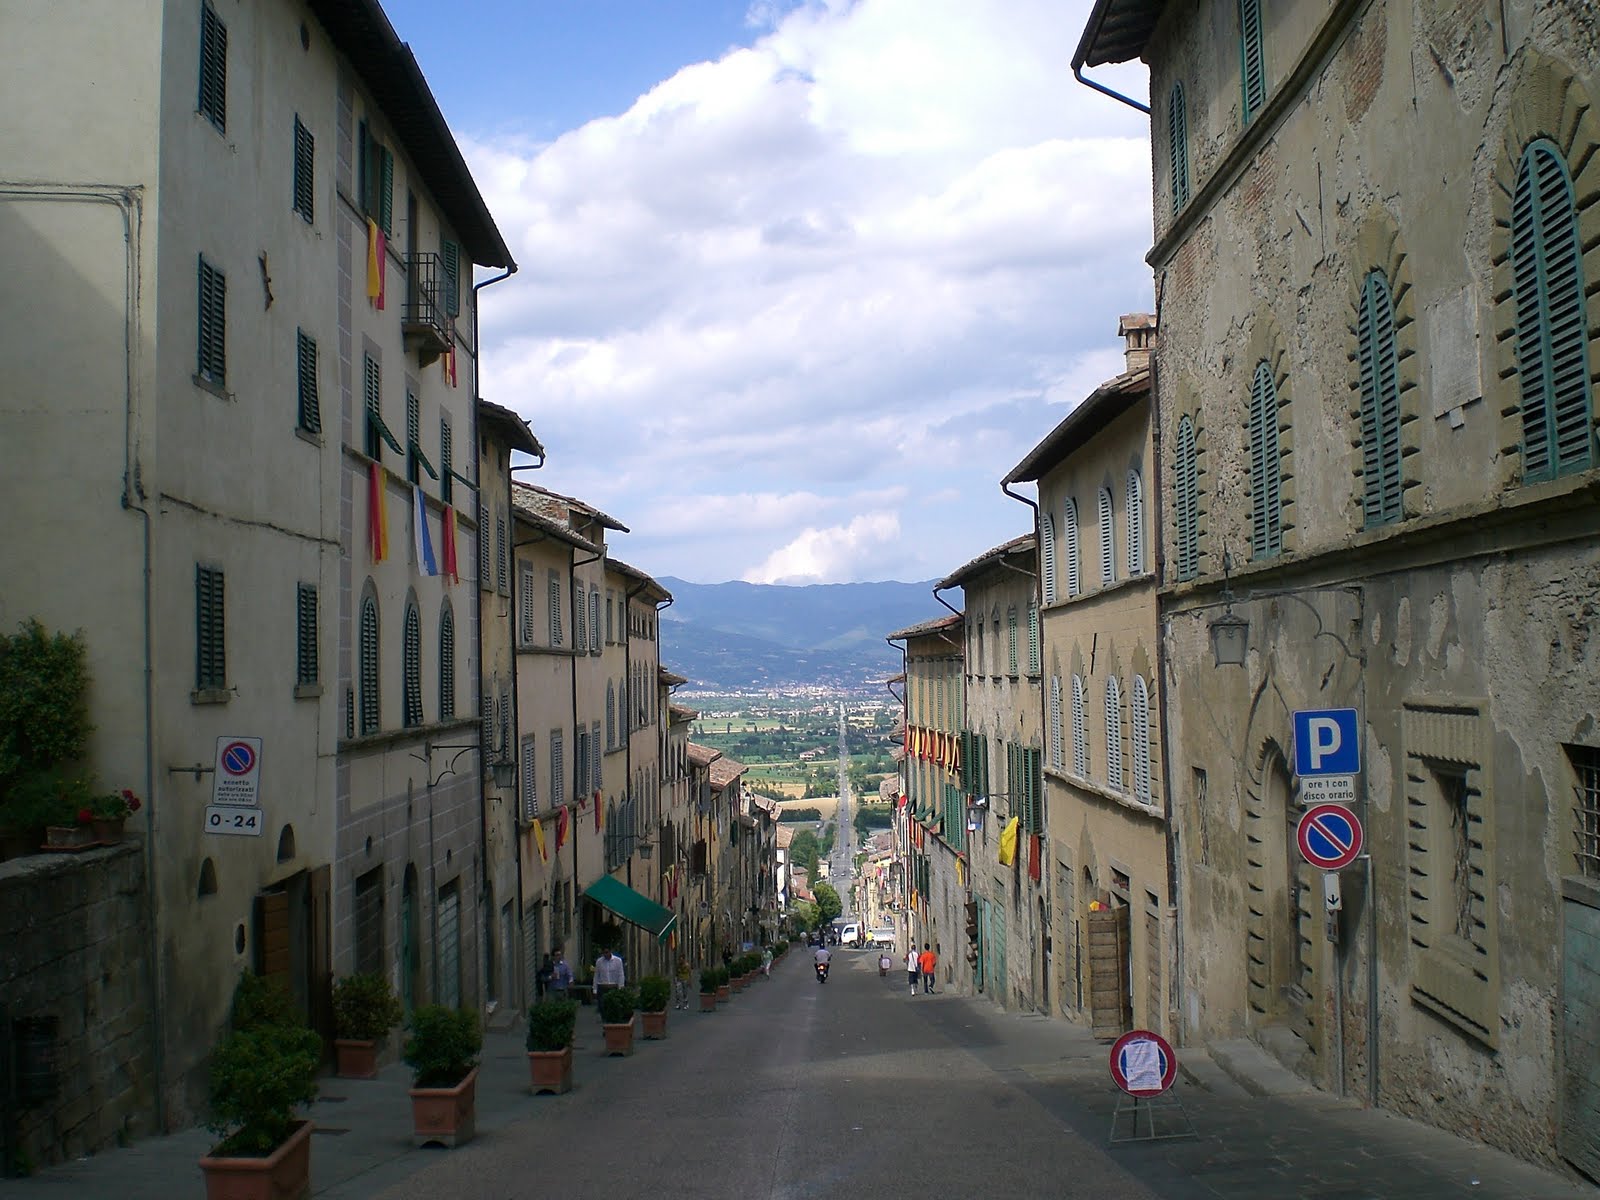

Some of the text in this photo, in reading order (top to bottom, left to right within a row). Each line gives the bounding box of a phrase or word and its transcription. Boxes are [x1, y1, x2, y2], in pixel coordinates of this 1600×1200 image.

[1309, 717, 1341, 769] P
[1308, 780, 1348, 789] ore 1 con
[1303, 790, 1354, 800] disco orario
[234, 815, 256, 828] 24
